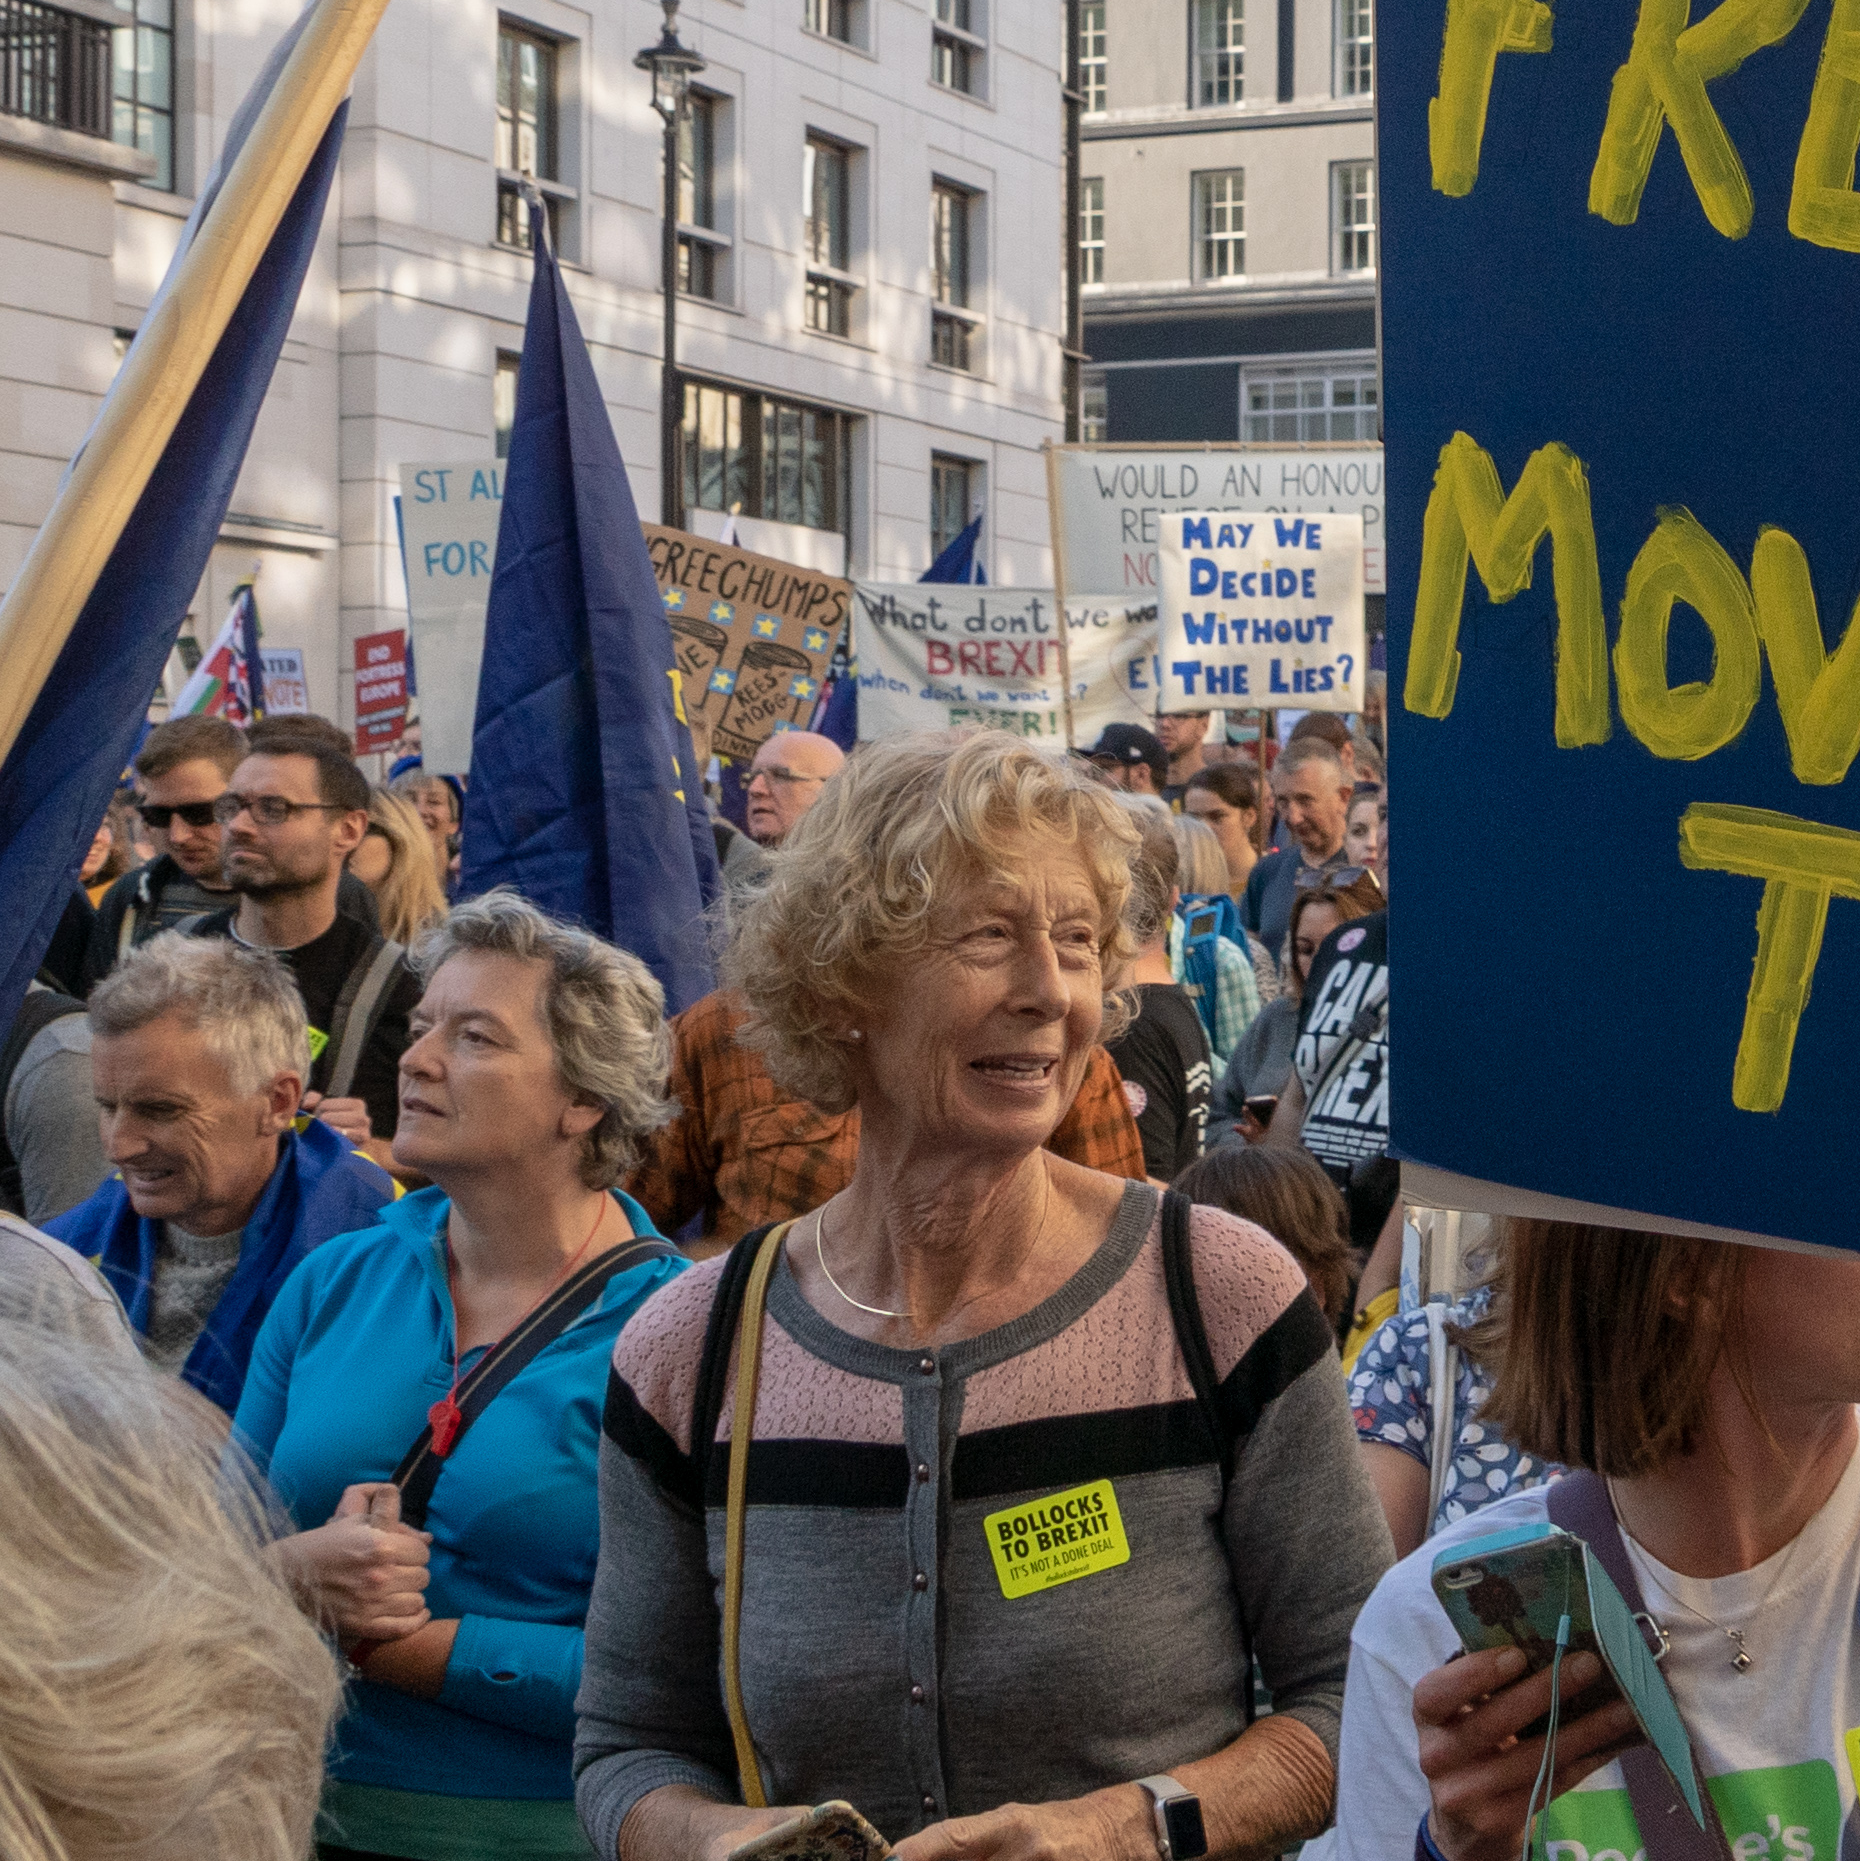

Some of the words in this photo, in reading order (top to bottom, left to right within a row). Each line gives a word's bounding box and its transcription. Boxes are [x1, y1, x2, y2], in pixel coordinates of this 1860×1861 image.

[414, 470, 452, 503] ST
[1095, 464, 1199, 499] WOULD
[1222, 464, 1261, 497] AN
[1182, 517, 1254, 550] MAY
[1274, 518, 1322, 551] WE
[424, 541, 492, 577] FOR
[648, 536, 847, 627] GREECHUMPS
[1190, 557, 1316, 600] DECIDE
[866, 594, 948, 632] What
[1064, 607, 1110, 628] we
[1182, 612, 1333, 645] WITHOUT
[926, 639, 1072, 677] BREXIT
[1172, 660, 1249, 696] THE
[1270, 653, 1354, 695] LIES?
[997, 1492, 1104, 1541] BOLLOCKS
[1001, 1538, 1029, 1563] TO
[1036, 1512, 1109, 1552] BREXIT
[1010, 1563, 1029, 1580] IT'S
[1030, 1556, 1051, 1574] NOT
[1053, 1555, 1061, 1568] A
[1062, 1544, 1090, 1564] DONE
[1091, 1537, 1115, 1554] DEAL
